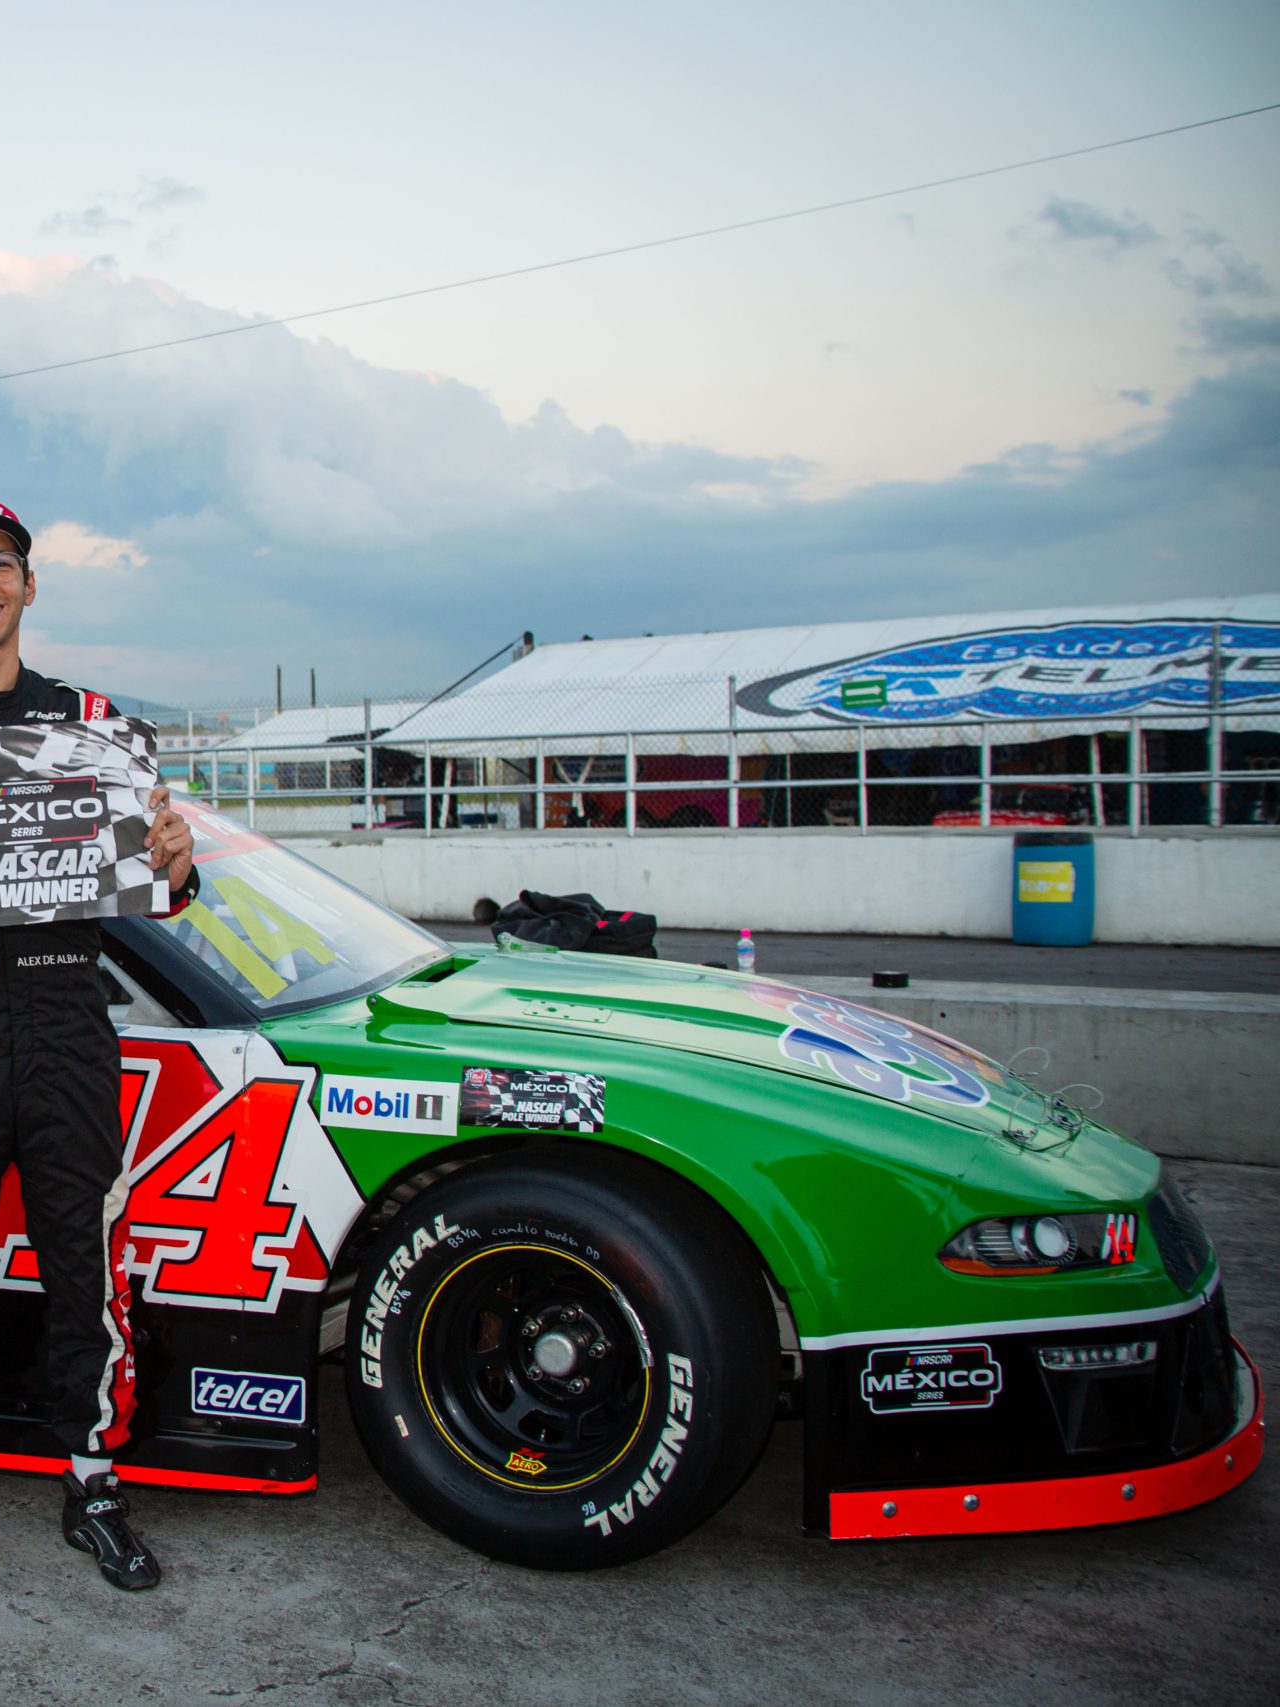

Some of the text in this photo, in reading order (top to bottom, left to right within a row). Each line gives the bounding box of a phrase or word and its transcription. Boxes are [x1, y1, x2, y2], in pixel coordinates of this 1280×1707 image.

[36, 711, 67, 721] telcel
[10, 784, 55, 796] NASCAR
[10, 826, 45, 838] SERIES
[17, 956, 42, 967] ALEX
[42, 955, 55, 965] DE
[56, 954, 79, 964] ALBA
[509, 1080, 569, 1094] MÉXICO
[327, 1086, 411, 1119] Mobil
[515, 1100, 564, 1115] NASCAR
[500, 1111, 561, 1125] POLE WINNER
[1106, 1219, 1136, 1265] 14
[361, 1213, 461, 1389] GENERAL
[916, 1354, 953, 1366] NASCAR
[866, 1368, 995, 1393] MÉXICO
[196, 1374, 298, 1416] telcel
[916, 1391, 945, 1401] SERIES
[583, 1352, 694, 1537] GENERAL
[512, 1459, 540, 1472] AERO
